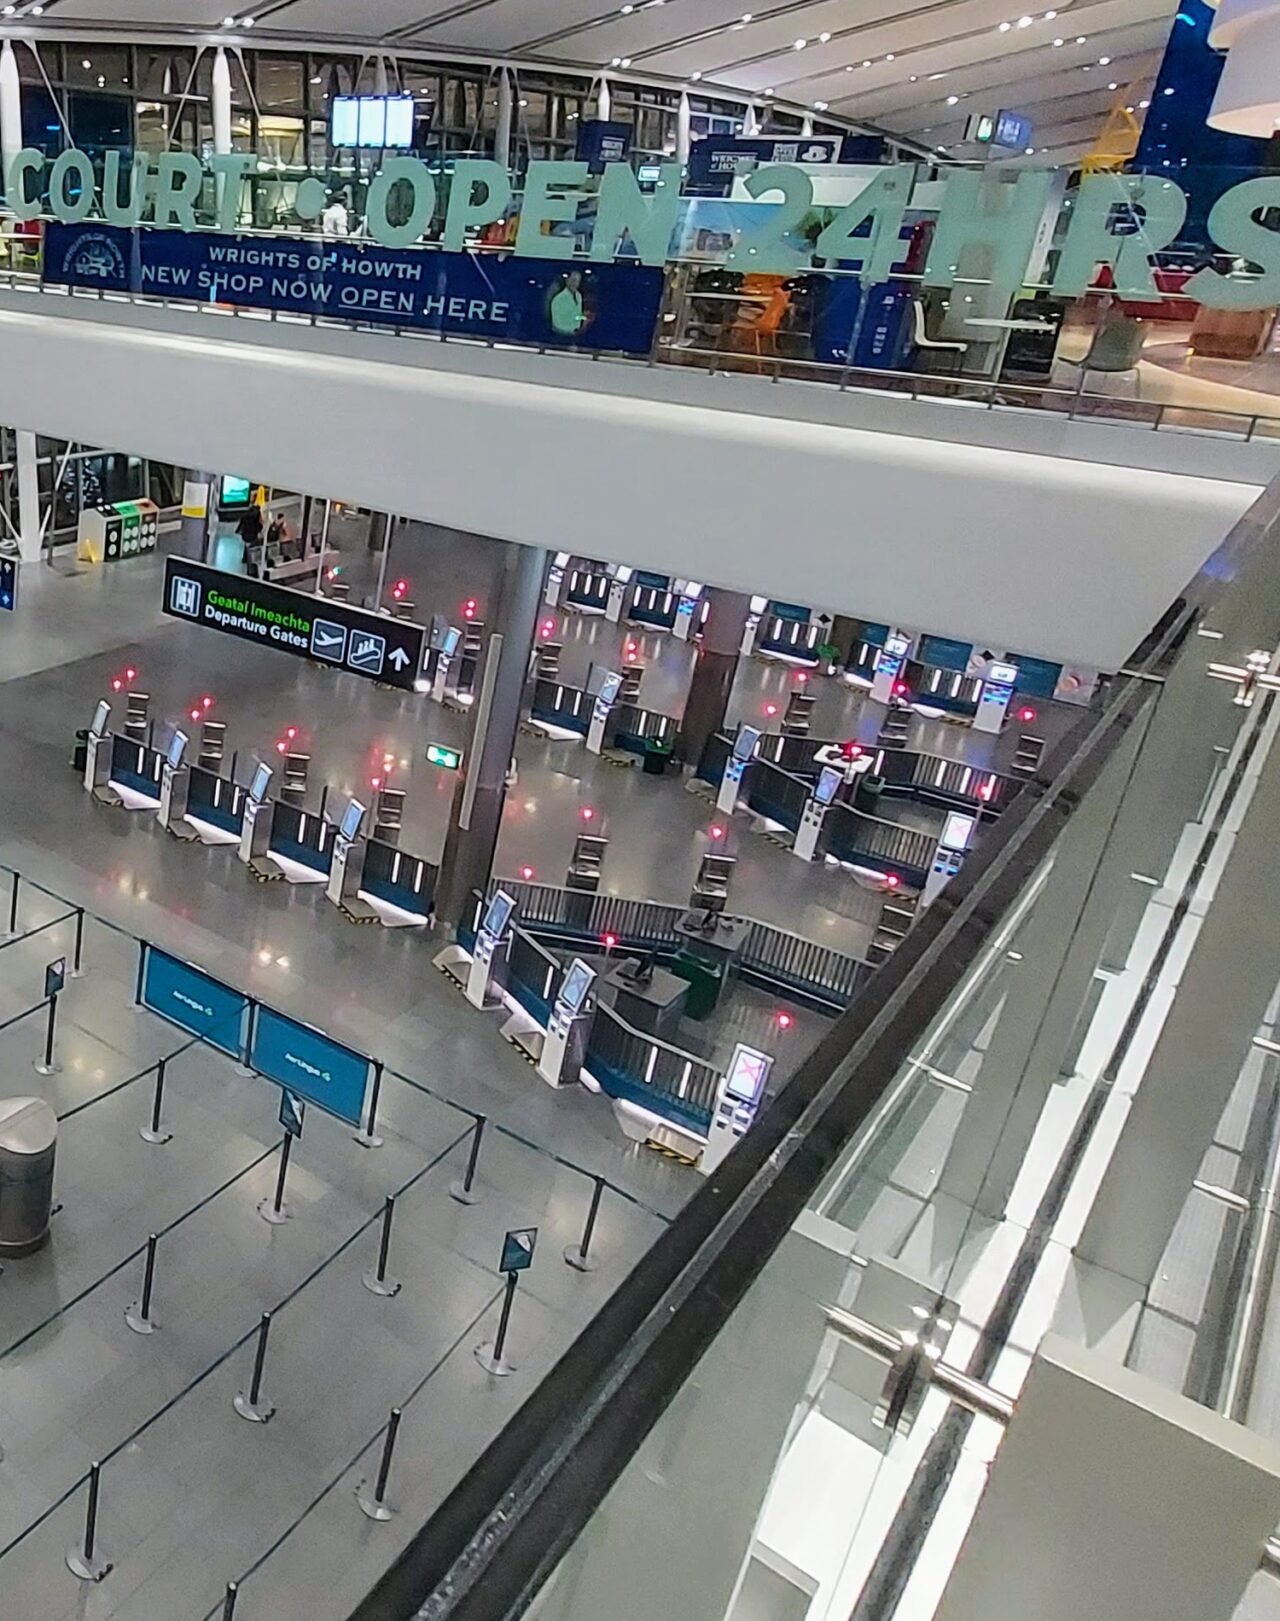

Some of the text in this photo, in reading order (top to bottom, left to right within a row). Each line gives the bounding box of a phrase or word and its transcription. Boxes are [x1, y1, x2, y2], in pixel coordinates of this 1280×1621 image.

[7, 147, 258, 236] COURT
[366, 156, 683, 267] OPEN
[209, 245, 422, 281] WRIGHTS OF HOWTH
[141, 264, 510, 323] NEW SHOP NOW OPEN HERE
[204, 603, 309, 649] Departure Gates
[250, 602, 311, 633] Imeachta
